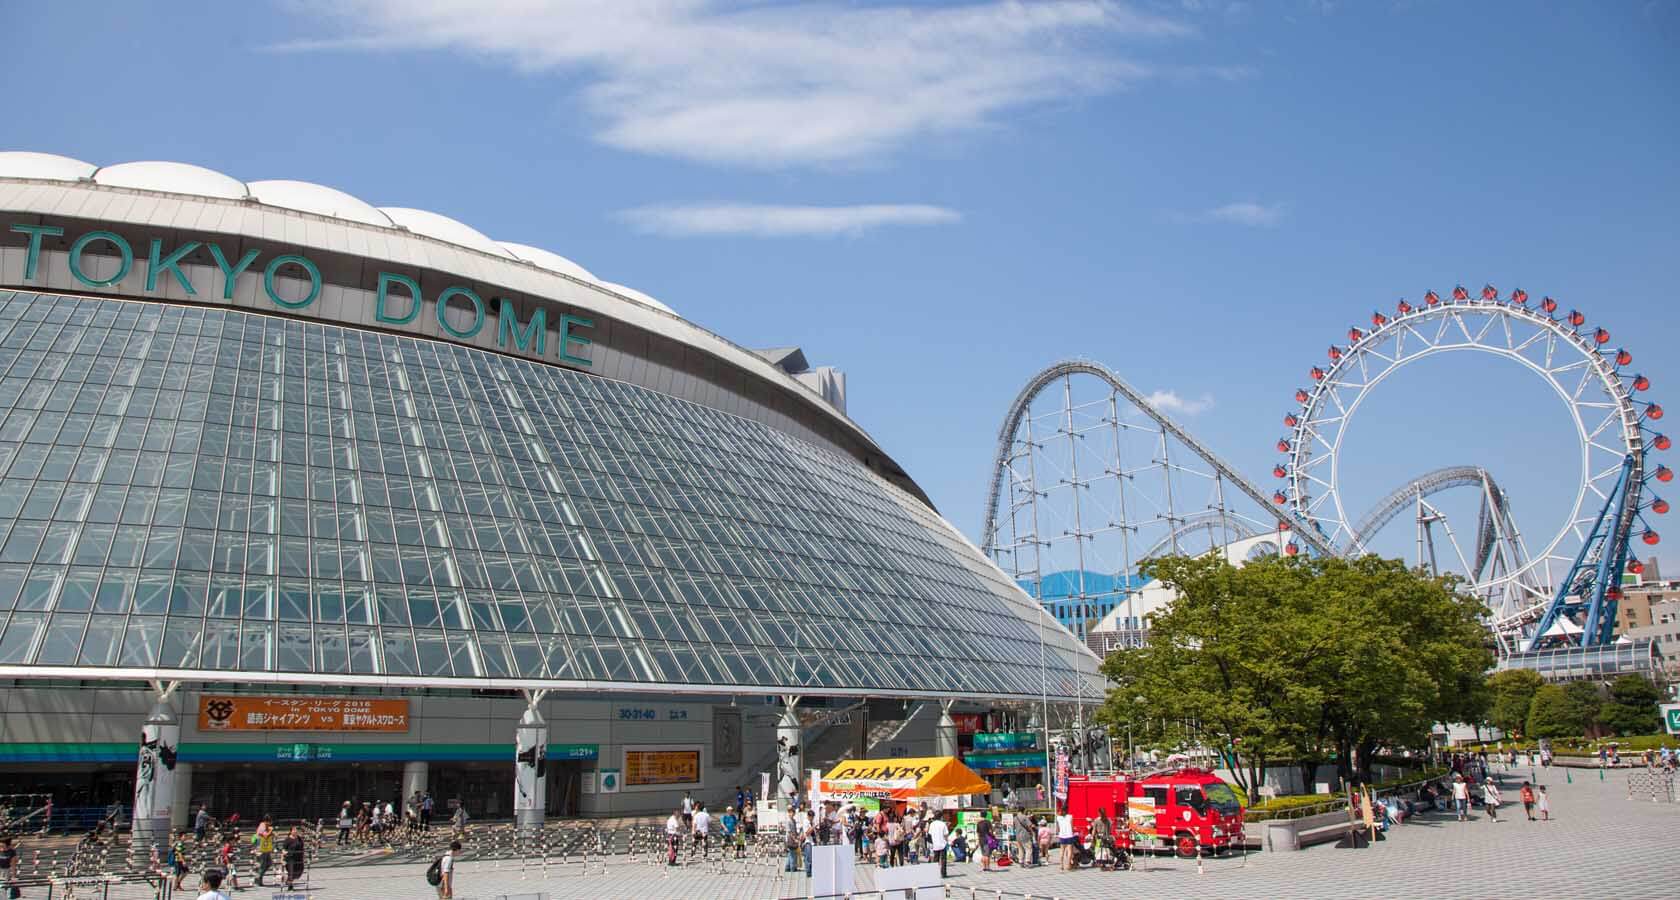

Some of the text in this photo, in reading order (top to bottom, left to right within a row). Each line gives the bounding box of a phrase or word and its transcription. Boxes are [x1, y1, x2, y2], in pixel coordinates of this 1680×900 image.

[10, 223, 593, 366] TOKYO DOME
[836, 766, 930, 781] GIANTS
